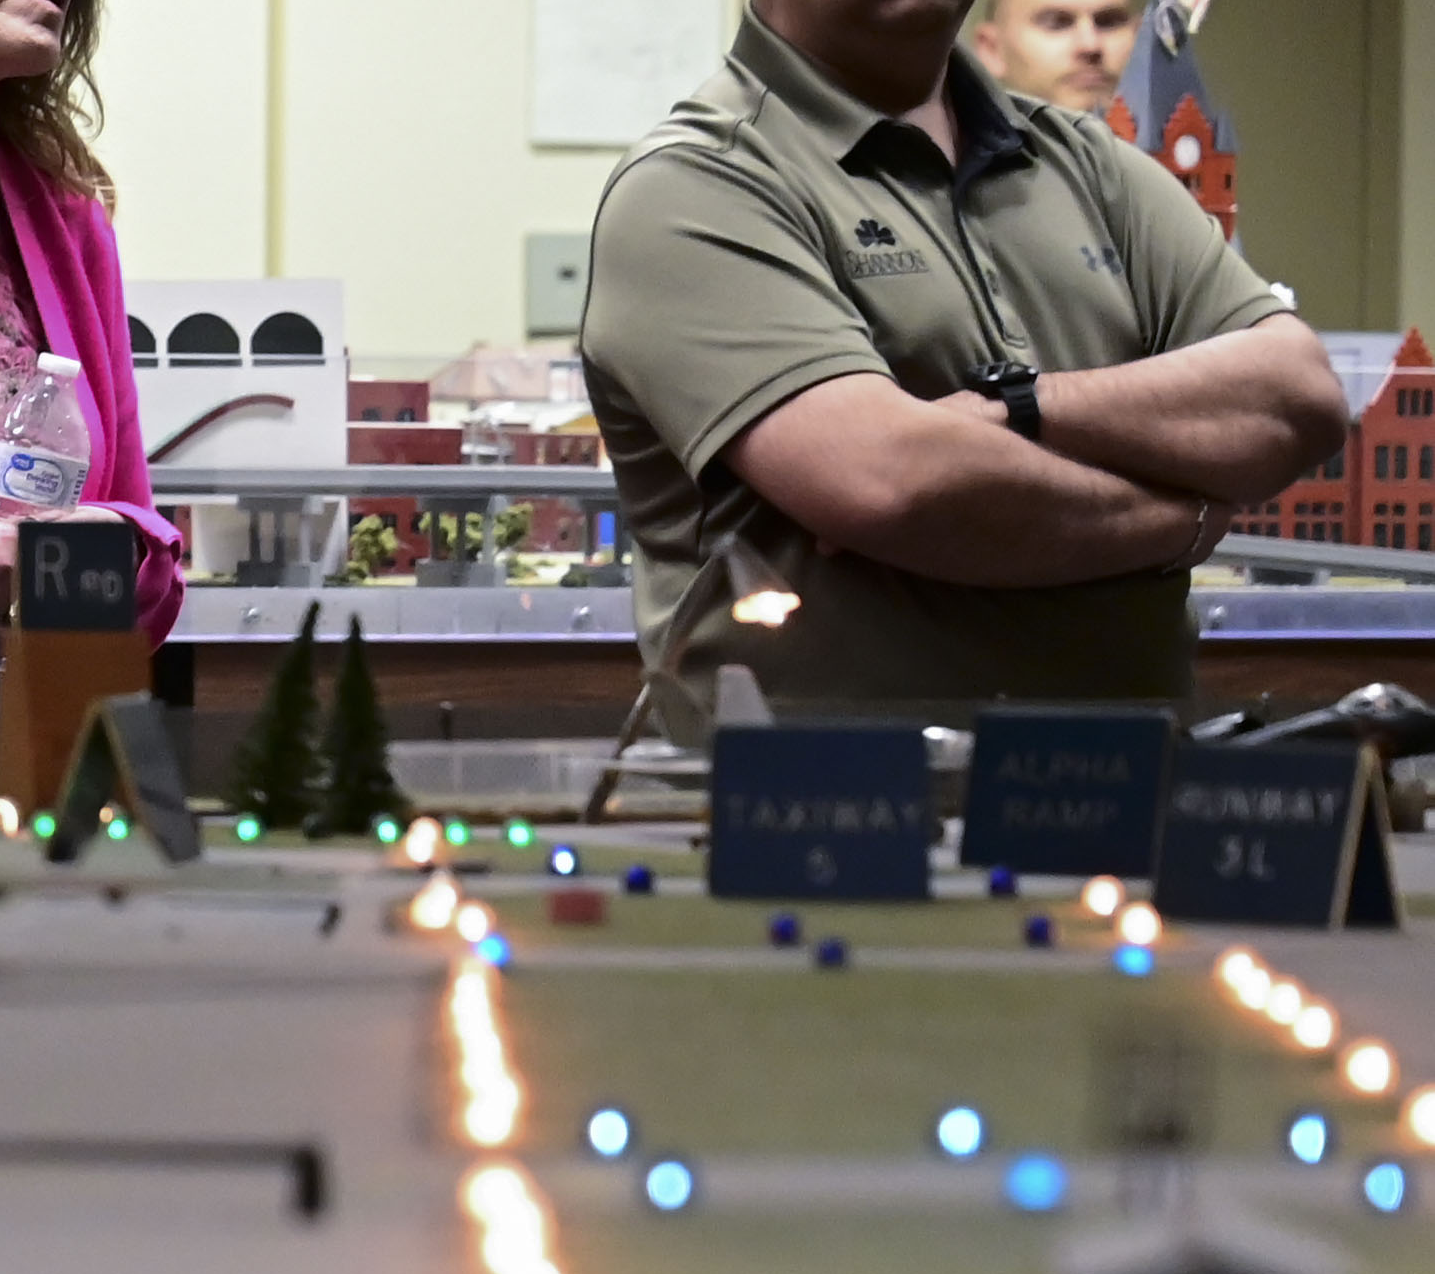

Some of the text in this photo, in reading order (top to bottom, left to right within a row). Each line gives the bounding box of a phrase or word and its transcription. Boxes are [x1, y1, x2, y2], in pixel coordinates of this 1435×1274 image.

[35, 535, 69, 600] R
[997, 750, 1131, 784] ALPHA
[724, 793, 925, 834] TAXIWAY
[1002, 795, 1121, 829] RAMP
[1172, 780, 1343, 826] RUNWAY
